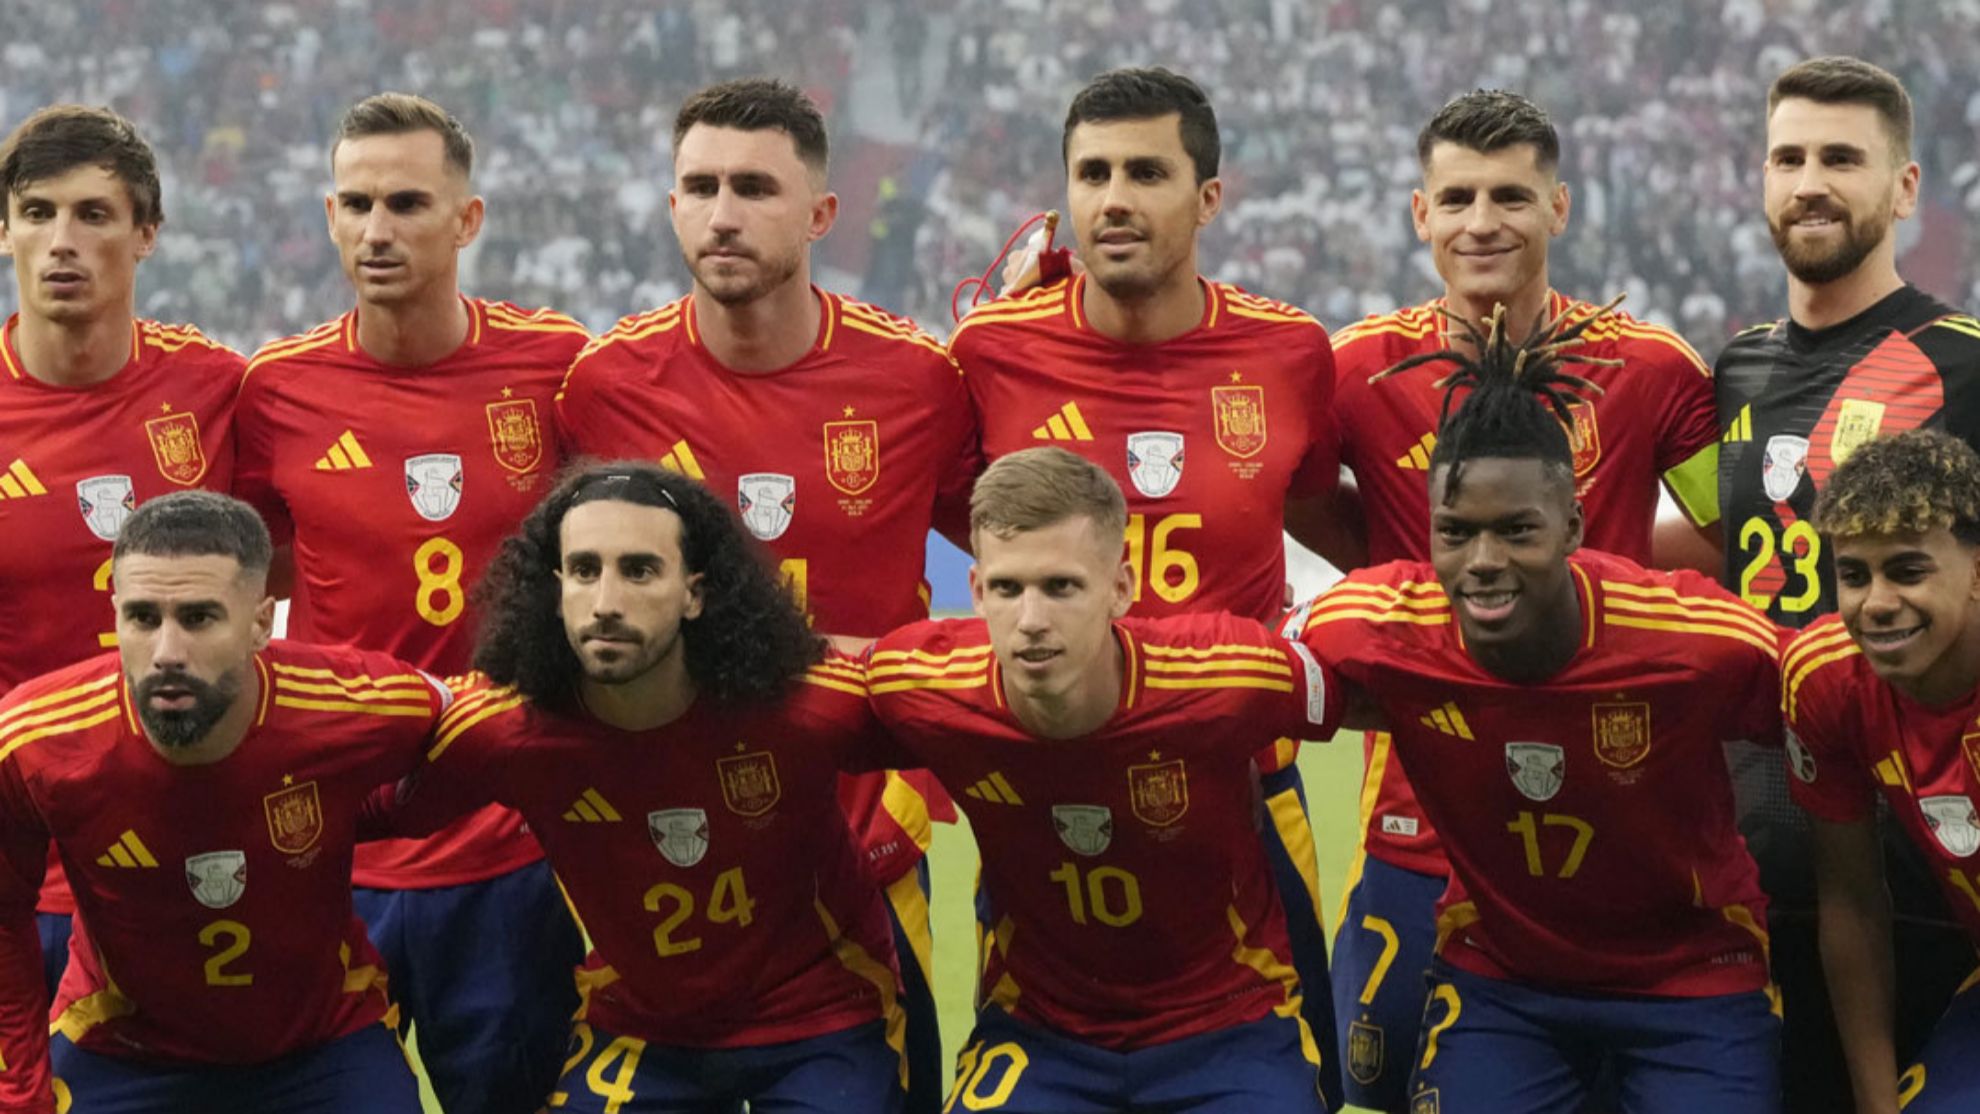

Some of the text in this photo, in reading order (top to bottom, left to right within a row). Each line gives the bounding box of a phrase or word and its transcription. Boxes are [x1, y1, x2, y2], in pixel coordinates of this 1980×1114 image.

[414, 537, 464, 627] 8
[1124, 513, 1202, 604] 16
[1740, 516, 1820, 612] 23
[1506, 811, 1594, 878] 17
[643, 866, 756, 957] 24
[1050, 861, 1143, 928] 10
[199, 919, 254, 987] 2
[1359, 914, 1400, 1005] 7
